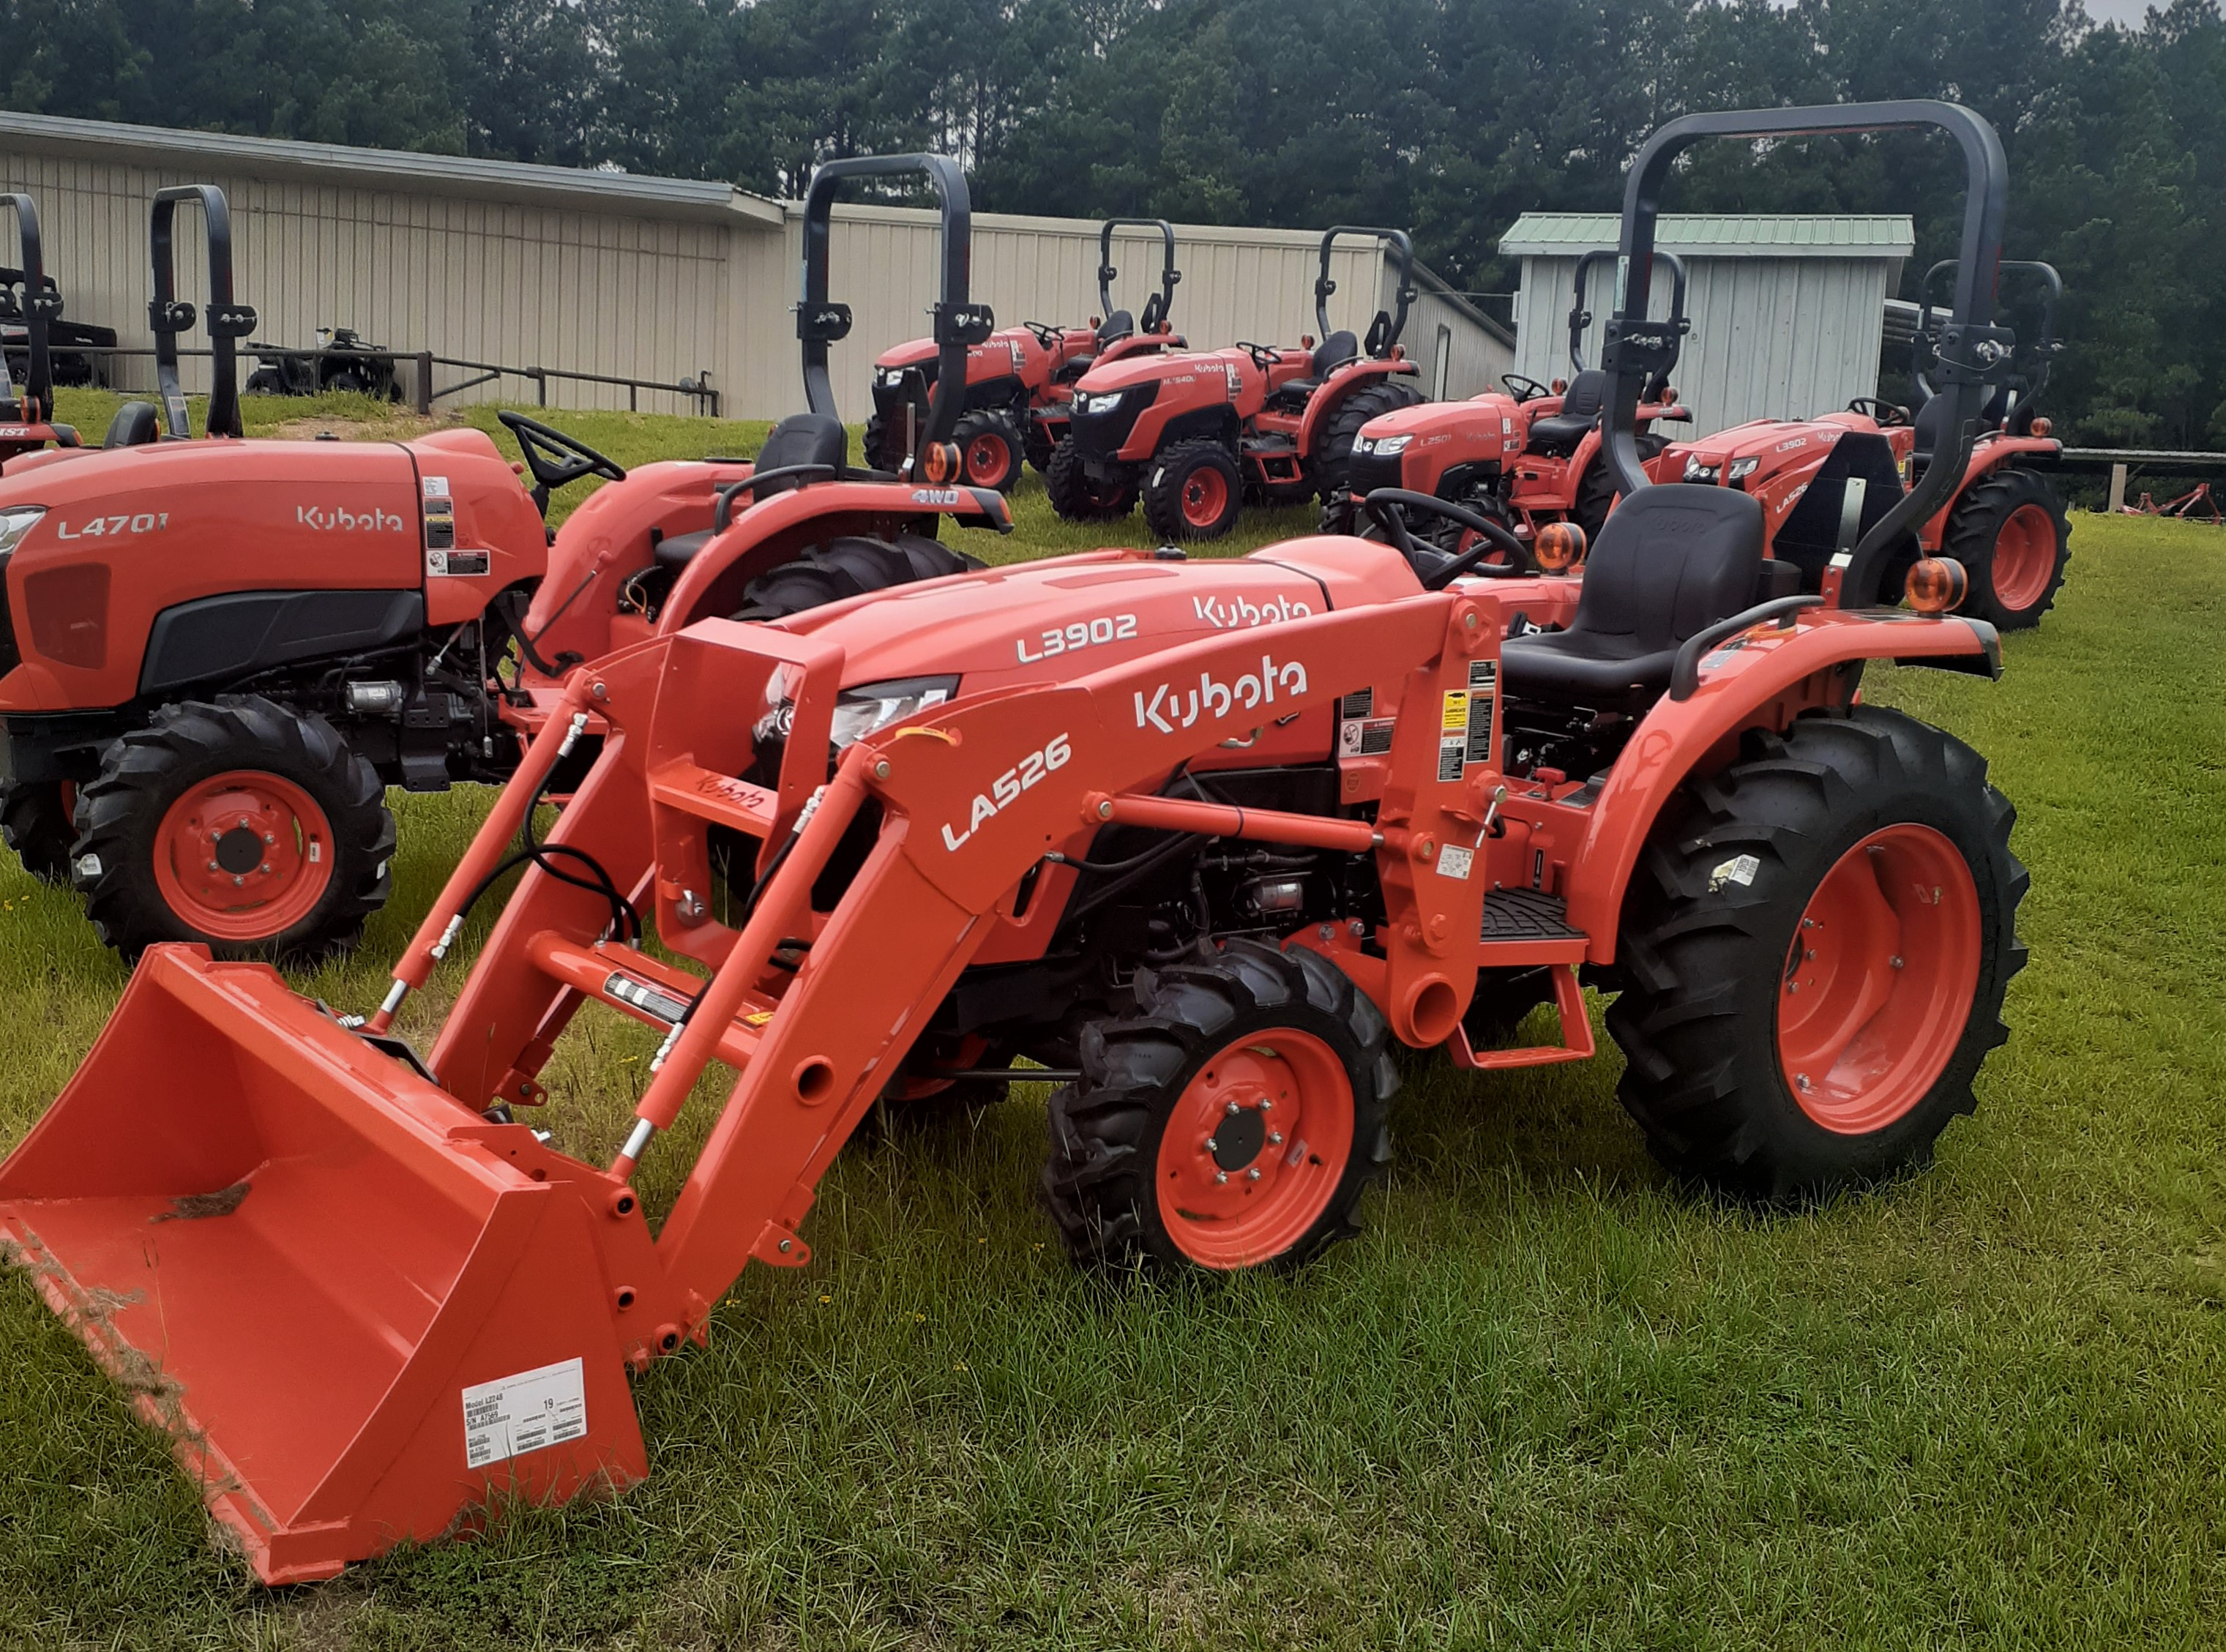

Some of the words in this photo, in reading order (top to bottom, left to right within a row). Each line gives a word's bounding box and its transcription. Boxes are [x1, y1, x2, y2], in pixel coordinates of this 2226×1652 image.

[1194, 363, 1225, 373] Kubota
[1419, 433, 1452, 447] L2501
[1776, 438, 1807, 453] L3902
[911, 489, 960, 504] 4WD
[1775, 481, 1809, 514] LA526
[58, 512, 169, 539] L4701
[296, 505, 403, 531] Kubota
[1192, 594, 1312, 628] Kubota
[1016, 613, 1138, 664] L3902
[1134, 654, 1308, 734] Kubota
[696, 775, 764, 808] Kubota
[941, 732, 1072, 852] LA526
[466, 1398, 484, 1410] Model
[544, 1398, 553, 1410] 19
[466, 1416, 477, 1426] S/N
